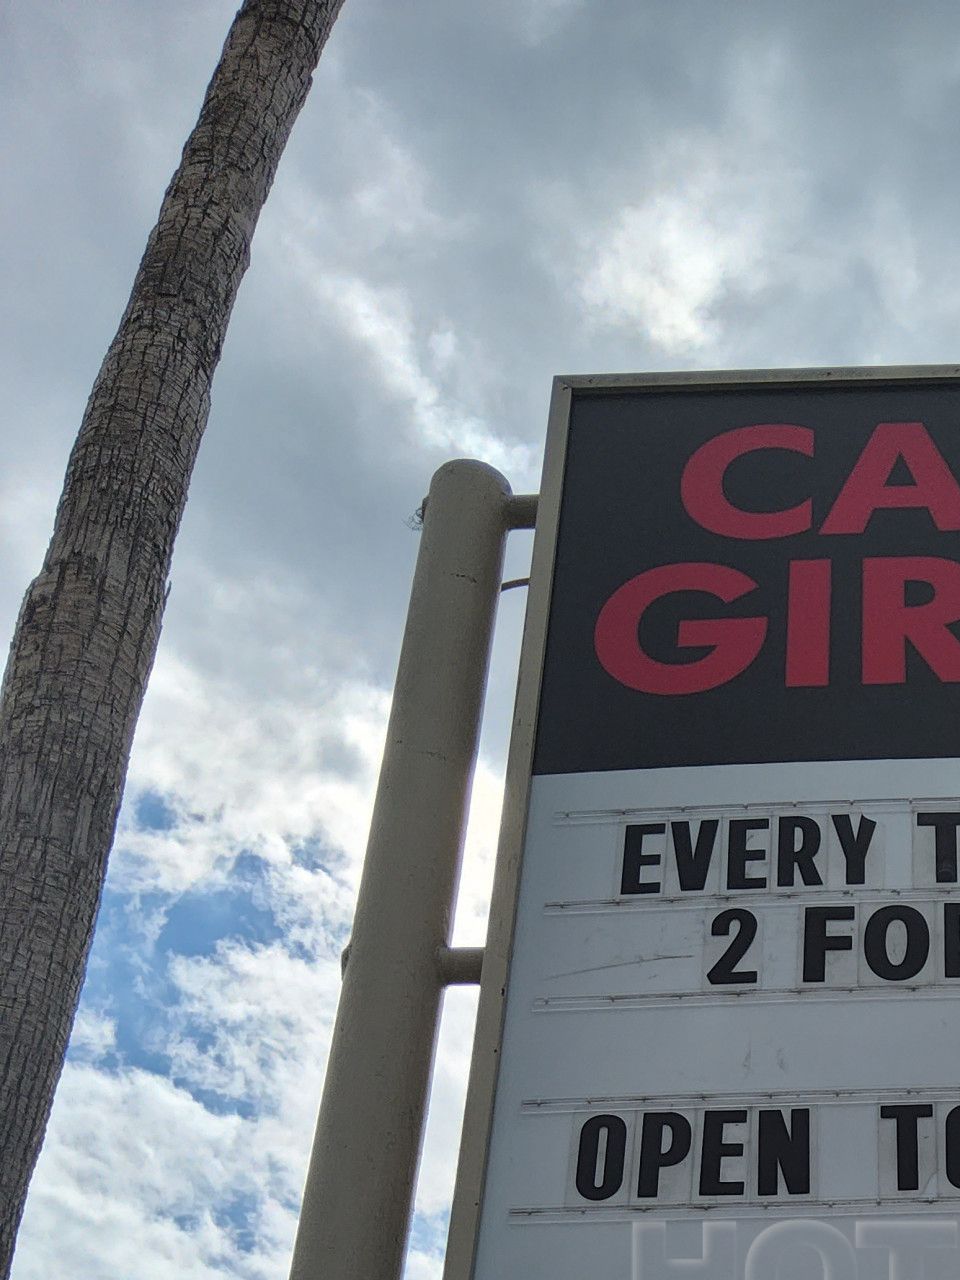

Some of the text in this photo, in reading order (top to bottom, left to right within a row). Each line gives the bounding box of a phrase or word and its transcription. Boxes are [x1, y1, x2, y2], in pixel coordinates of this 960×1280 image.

[619, 812, 877, 896] EVERY
[706, 907, 758, 986] 2
[574, 1107, 811, 1202] OPEN
